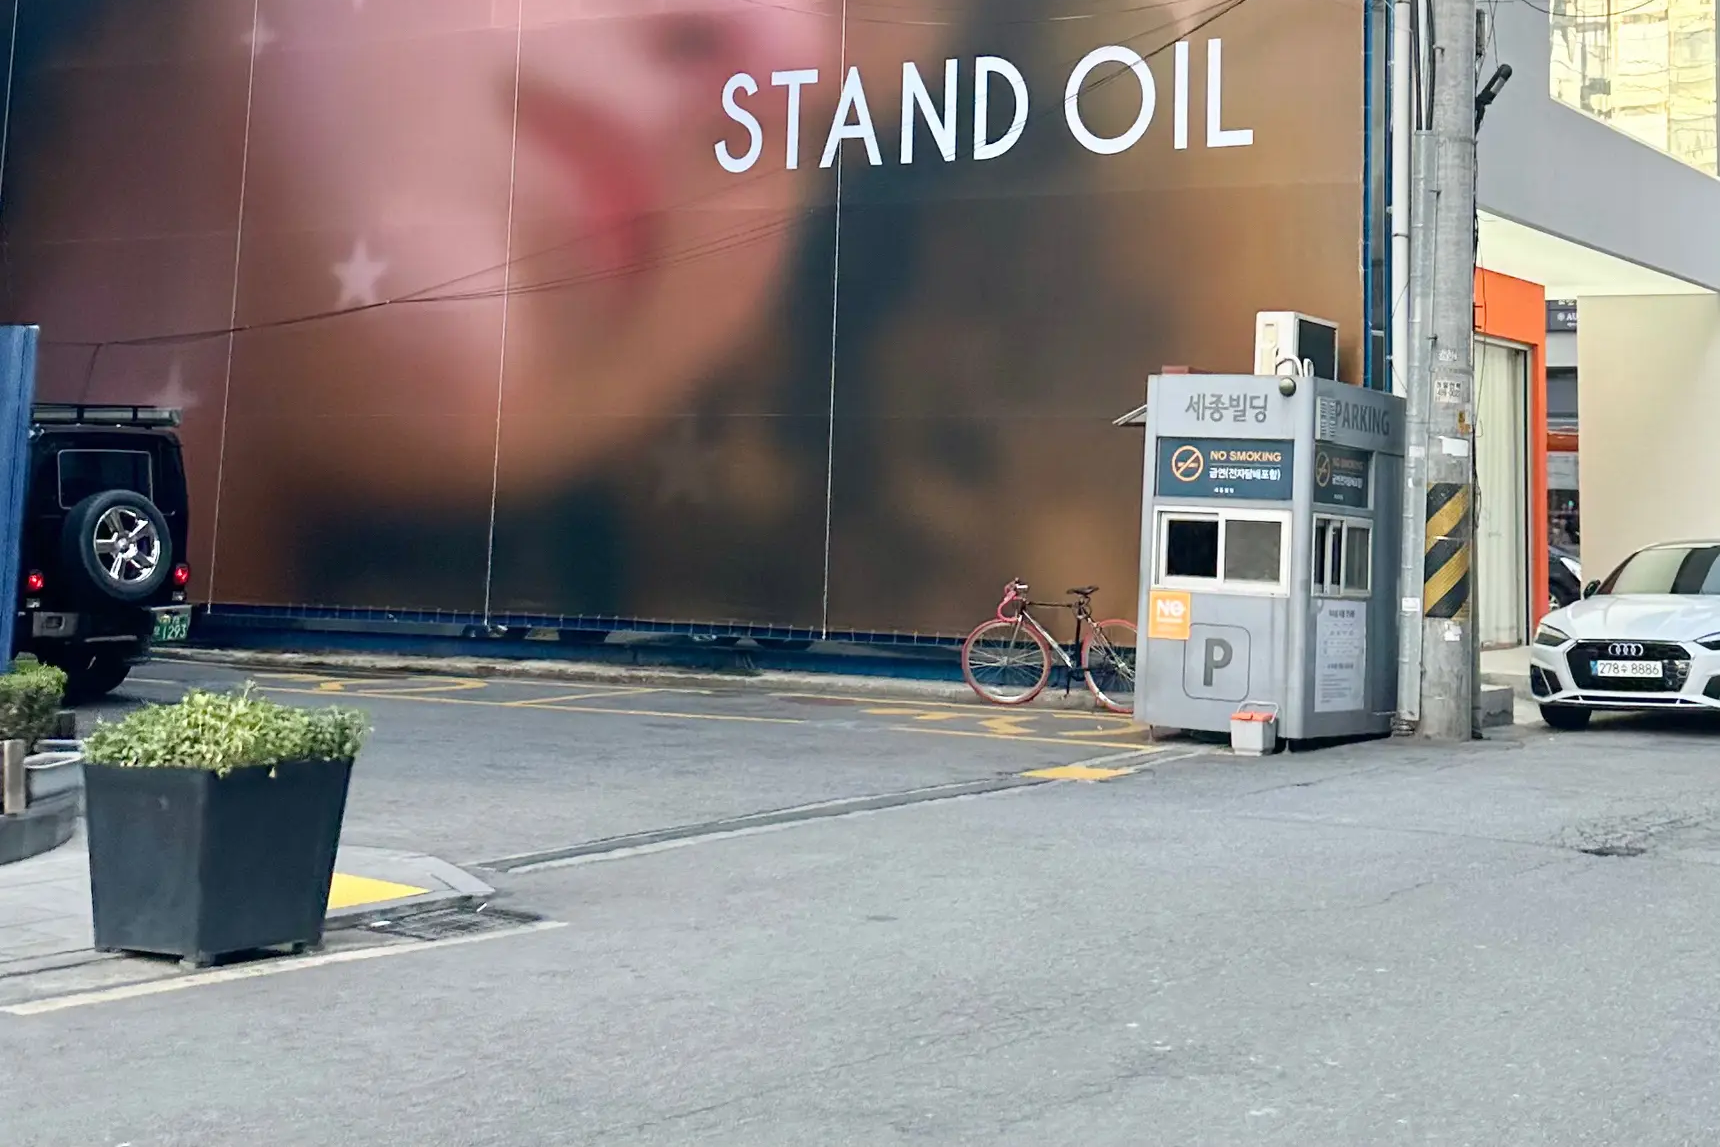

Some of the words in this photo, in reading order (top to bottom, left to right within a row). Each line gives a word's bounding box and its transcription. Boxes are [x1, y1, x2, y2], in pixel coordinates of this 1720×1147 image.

[713, 55, 1029, 174] STAND
[1063, 37, 1254, 155] OIL
[1185, 393, 1268, 423] 세종빌딩
[1335, 400, 1390, 436] PARKING
[1210, 450, 1228, 461] NO
[1229, 451, 1282, 462] SMOKING
[1203, 638, 1233, 687] P
[1631, 663, 1660, 675] 8886
